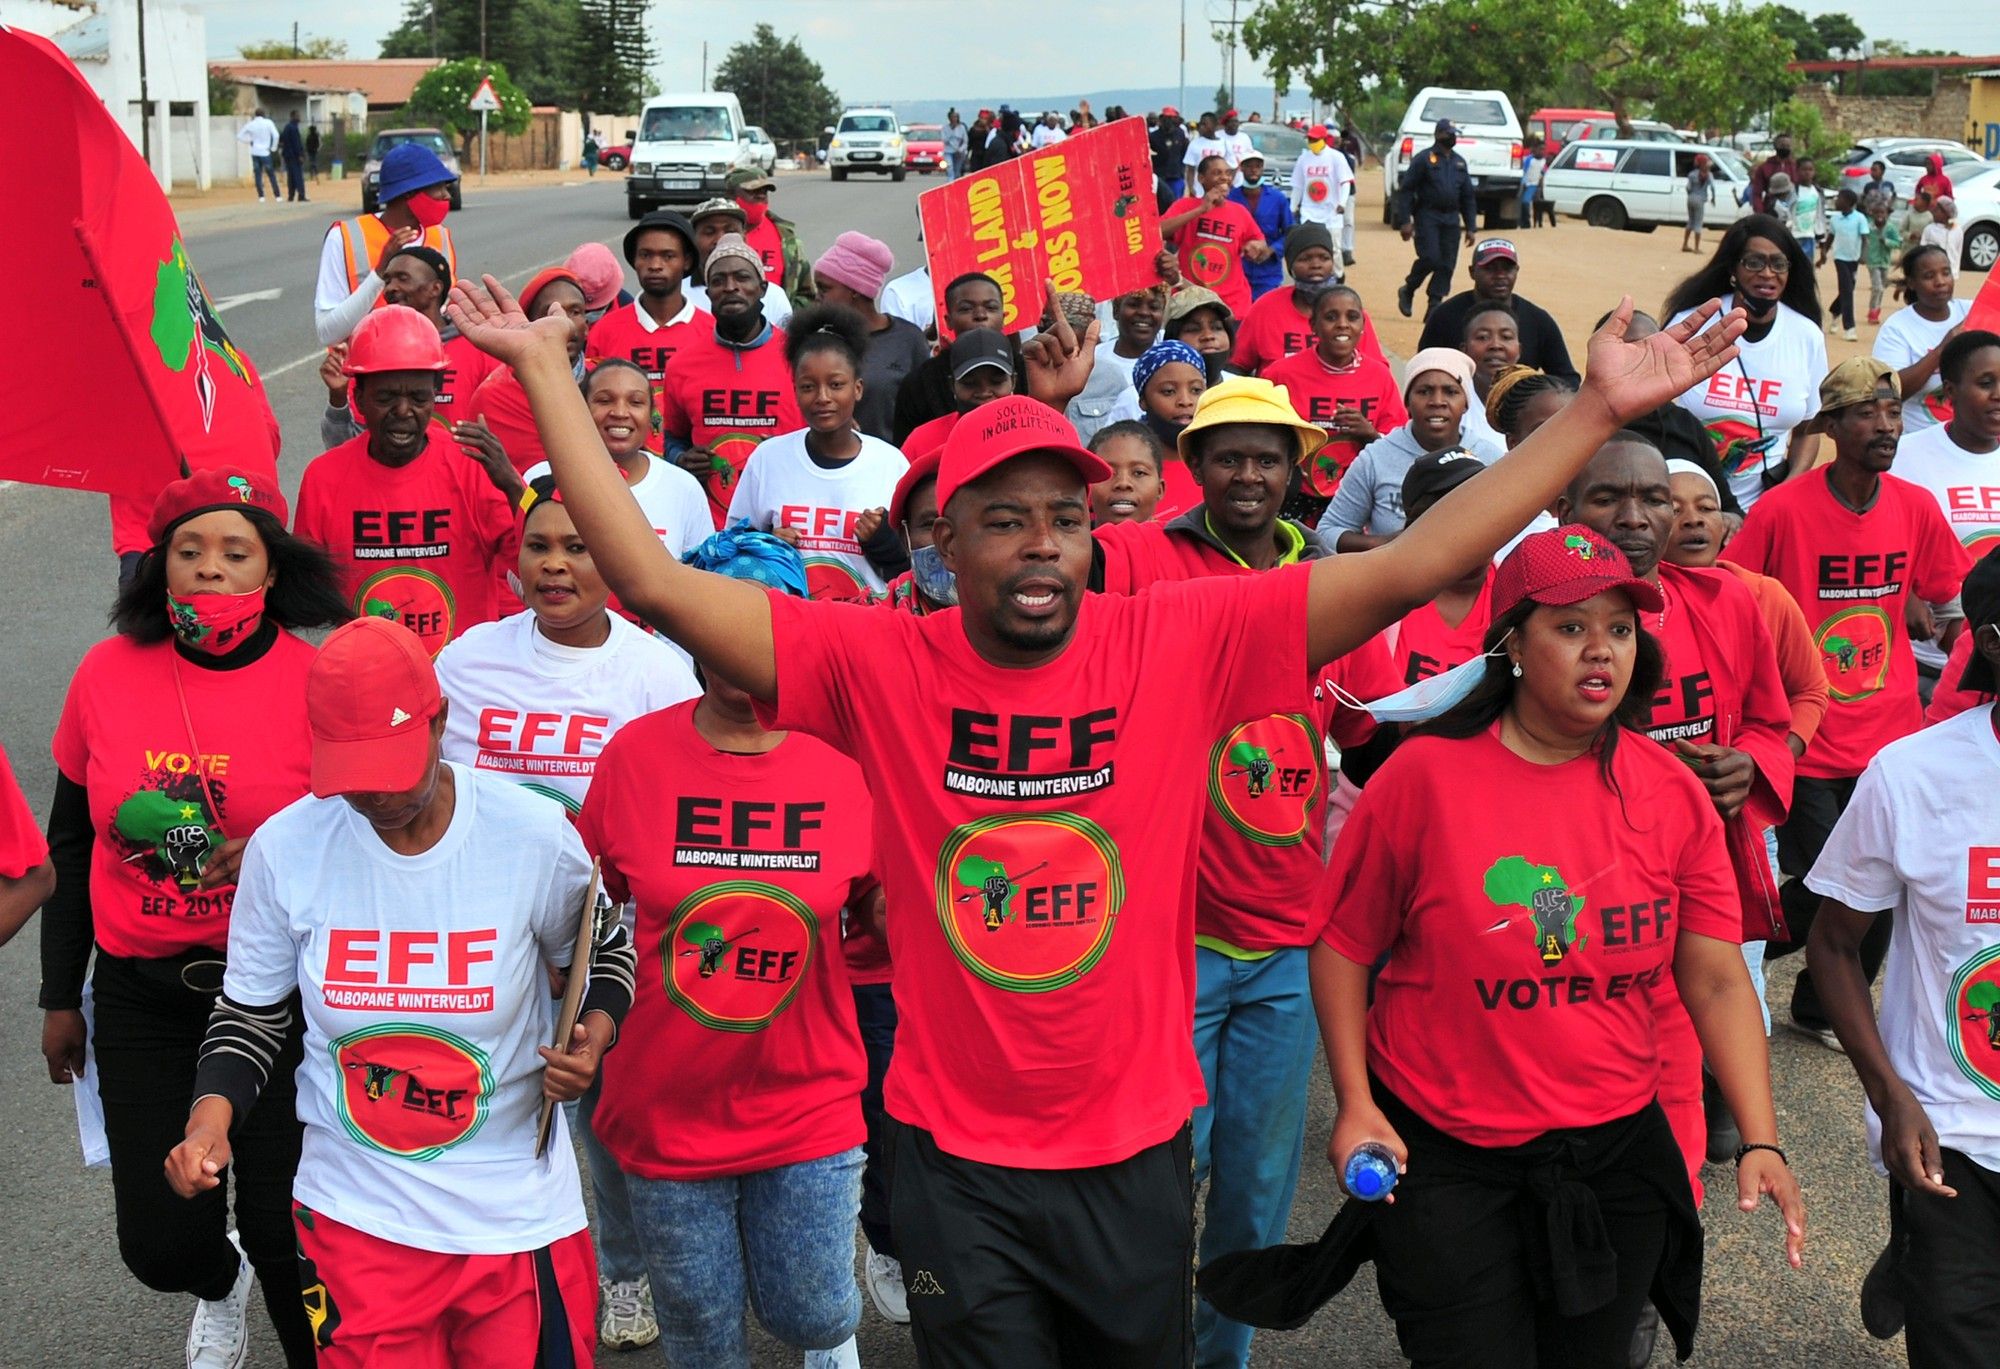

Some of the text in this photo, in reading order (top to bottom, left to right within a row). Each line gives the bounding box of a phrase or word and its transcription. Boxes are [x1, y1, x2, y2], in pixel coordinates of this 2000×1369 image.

[967, 178, 1009, 263] LAND
[1033, 154, 1086, 294] OBS NOW
[1118, 165, 1144, 255] VOTE EFF
[1012, 229, 1038, 249] &
[1197, 218, 1236, 237] EFF
[1284, 332, 1320, 353] EF
[631, 347, 676, 370] EF
[703, 389, 781, 415] EFF
[1709, 372, 1782, 403] EFF
[995, 418, 1017, 435] OUR
[353, 509, 451, 544] EFF
[355, 545, 448, 558] MABOPANE WINTERVELDT
[1819, 551, 1908, 585] EFF
[404, 611, 441, 633] EFF
[478, 708, 609, 755] EFF
[947, 706, 1117, 773] EFF
[145, 750, 231, 776] VOTE
[478, 753, 597, 774] MABOPANE WINTERVELDT
[946, 767, 1112, 797] MABOPANE WINTERVELDT
[675, 796, 826, 849] EFF
[676, 850, 818, 869] MABOPANE WINTERVELDT
[141, 896, 177, 916] EFF
[1026, 882, 1097, 922] EFF
[1601, 898, 1672, 947] EFF
[325, 928, 498, 986] EFF
[735, 947, 799, 979] EFF
[325, 989, 490, 1010] MABOPANE WINTERVELDT
[1474, 975, 1595, 1011] VOTE
